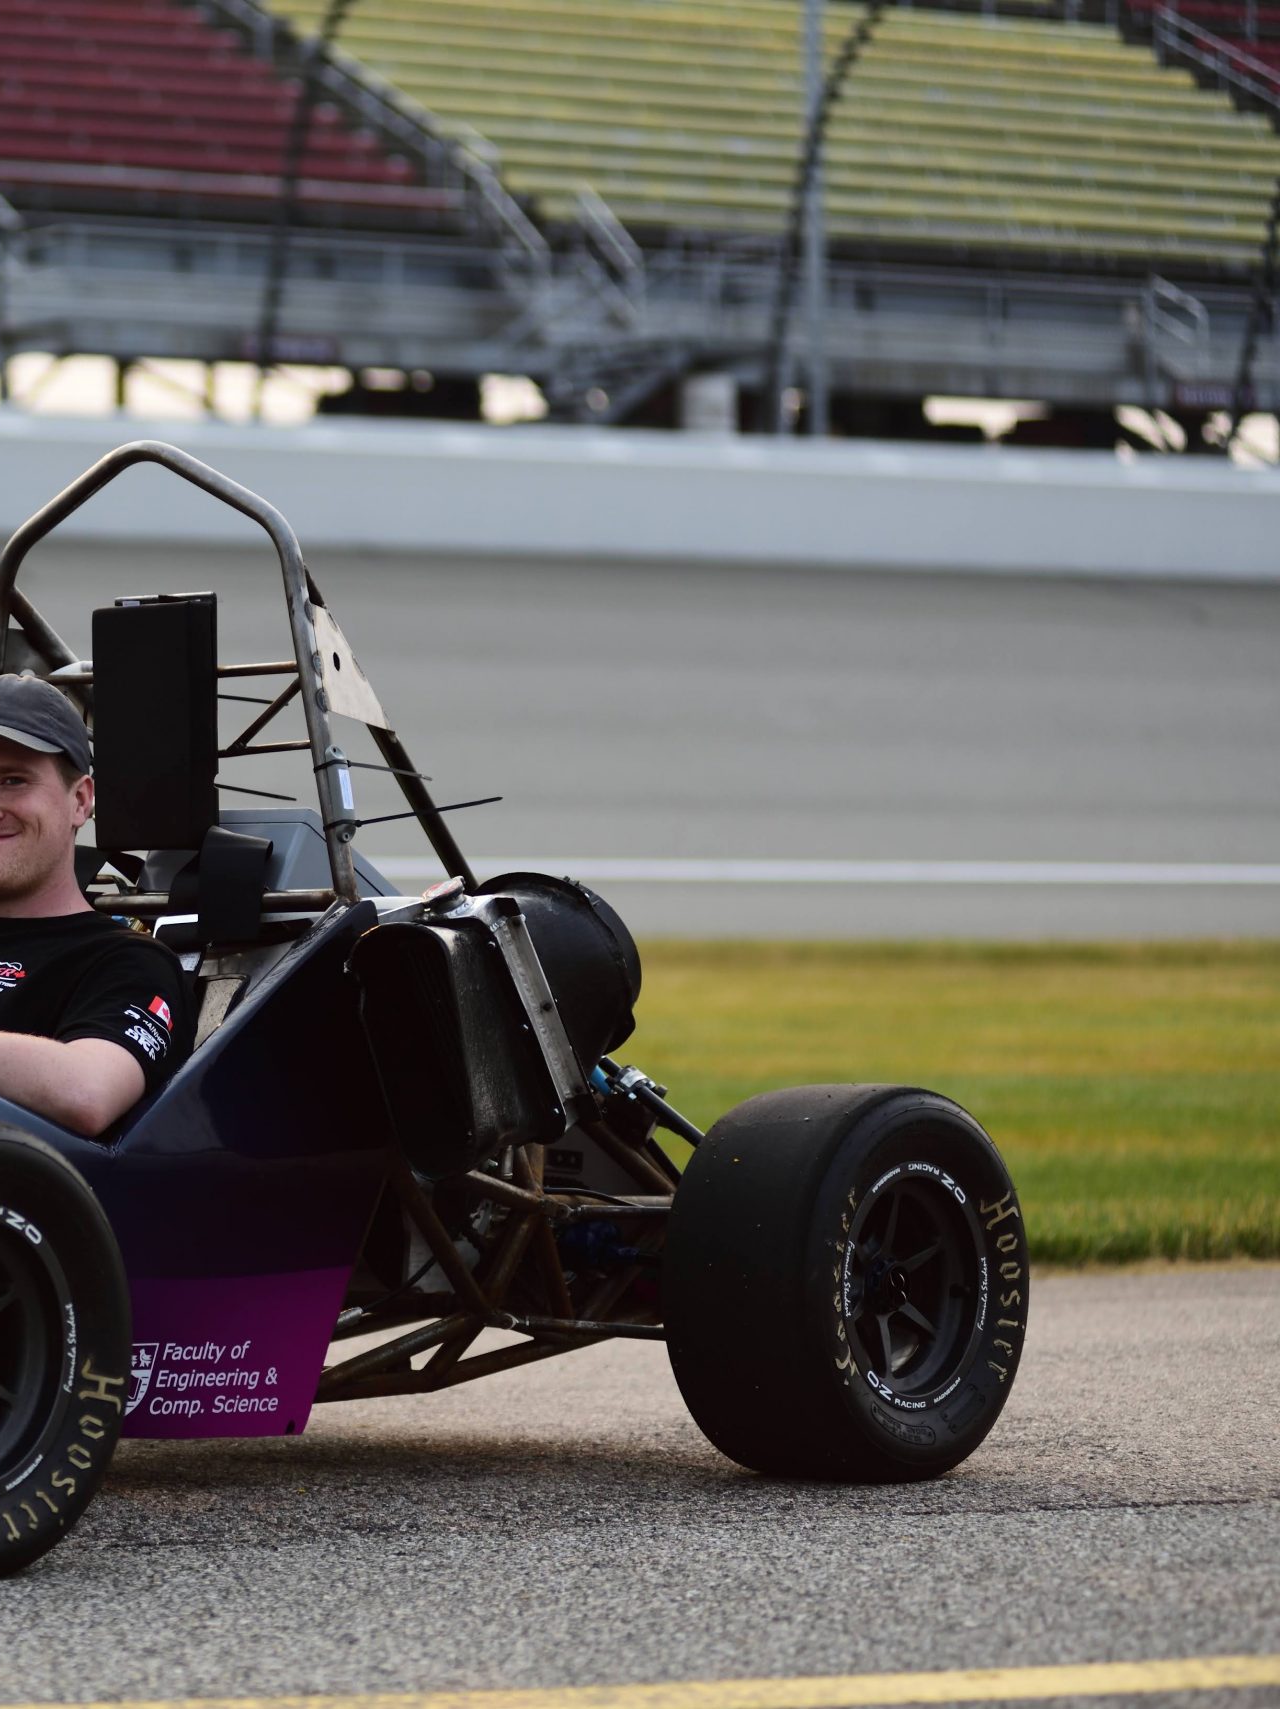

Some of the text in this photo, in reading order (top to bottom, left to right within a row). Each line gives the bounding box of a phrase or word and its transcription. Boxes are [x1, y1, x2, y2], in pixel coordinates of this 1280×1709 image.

[908, 1162, 940, 1176] RACING
[843, 1240, 856, 1318] Formula Student
[976, 1256, 989, 1331] Formula Student
[62, 1302, 77, 1394] Formula Student
[162, 1340, 251, 1364] Faculty of
[156, 1367, 278, 1392] Engineering &
[149, 1395, 279, 1418] Comp. Science
[894, 1398, 927, 1409] RACING
